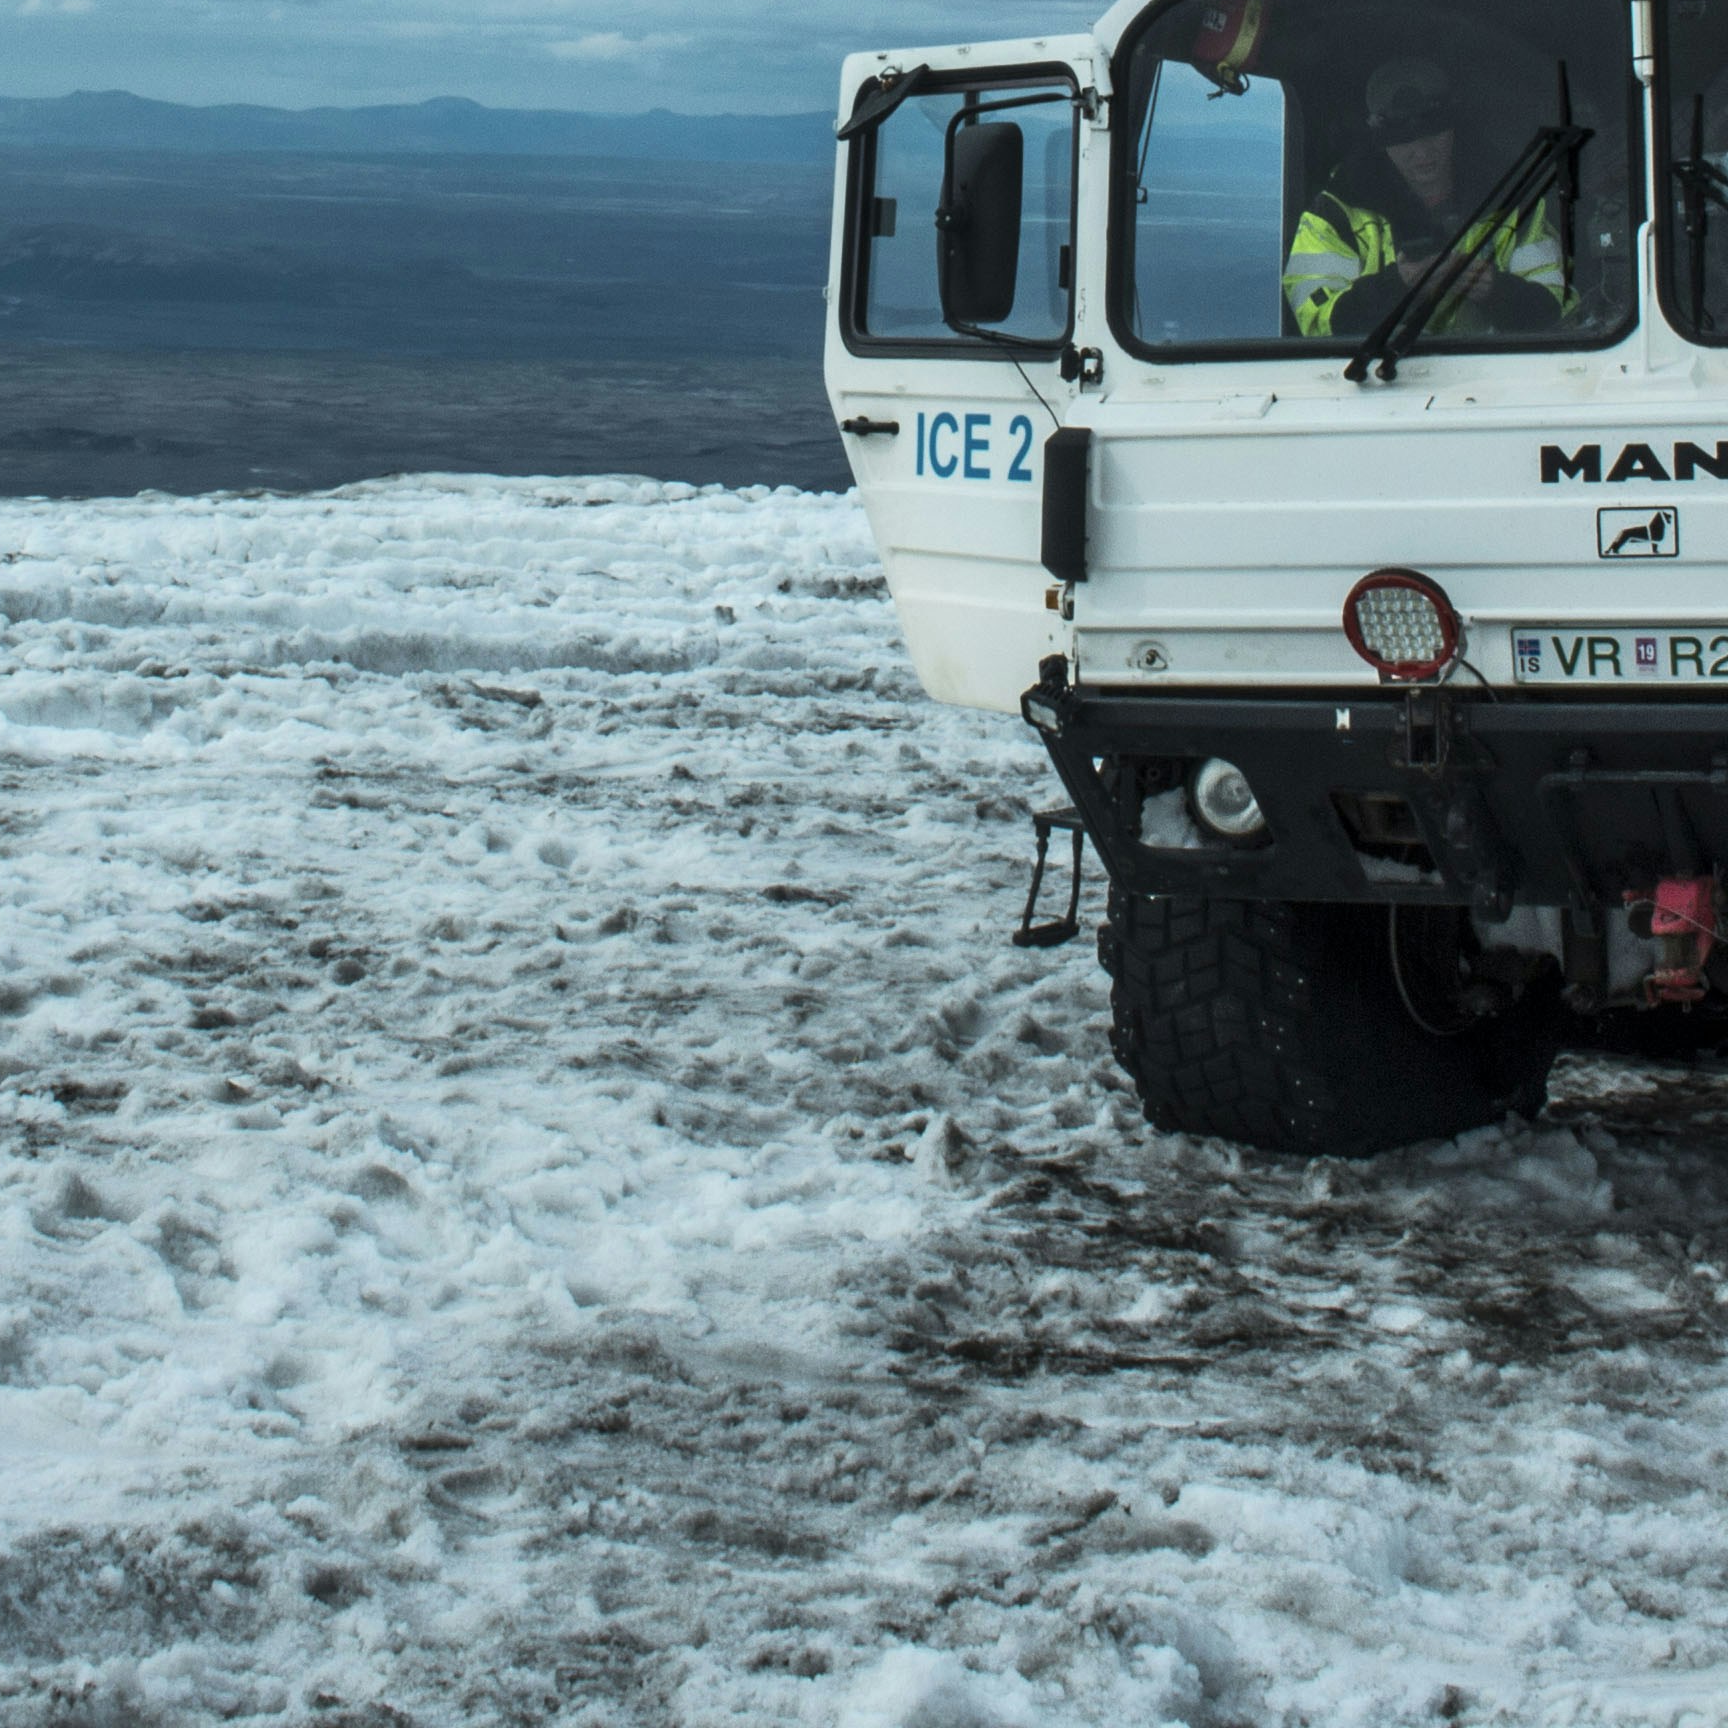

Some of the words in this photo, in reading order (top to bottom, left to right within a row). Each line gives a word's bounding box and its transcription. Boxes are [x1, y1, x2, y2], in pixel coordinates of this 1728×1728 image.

[916, 411, 991, 479] ICE
[1007, 414, 1033, 482] 2
[1519, 656, 1541, 674] IS
[1551, 635, 1623, 677] VR
[1638, 644, 1655, 661] 19
